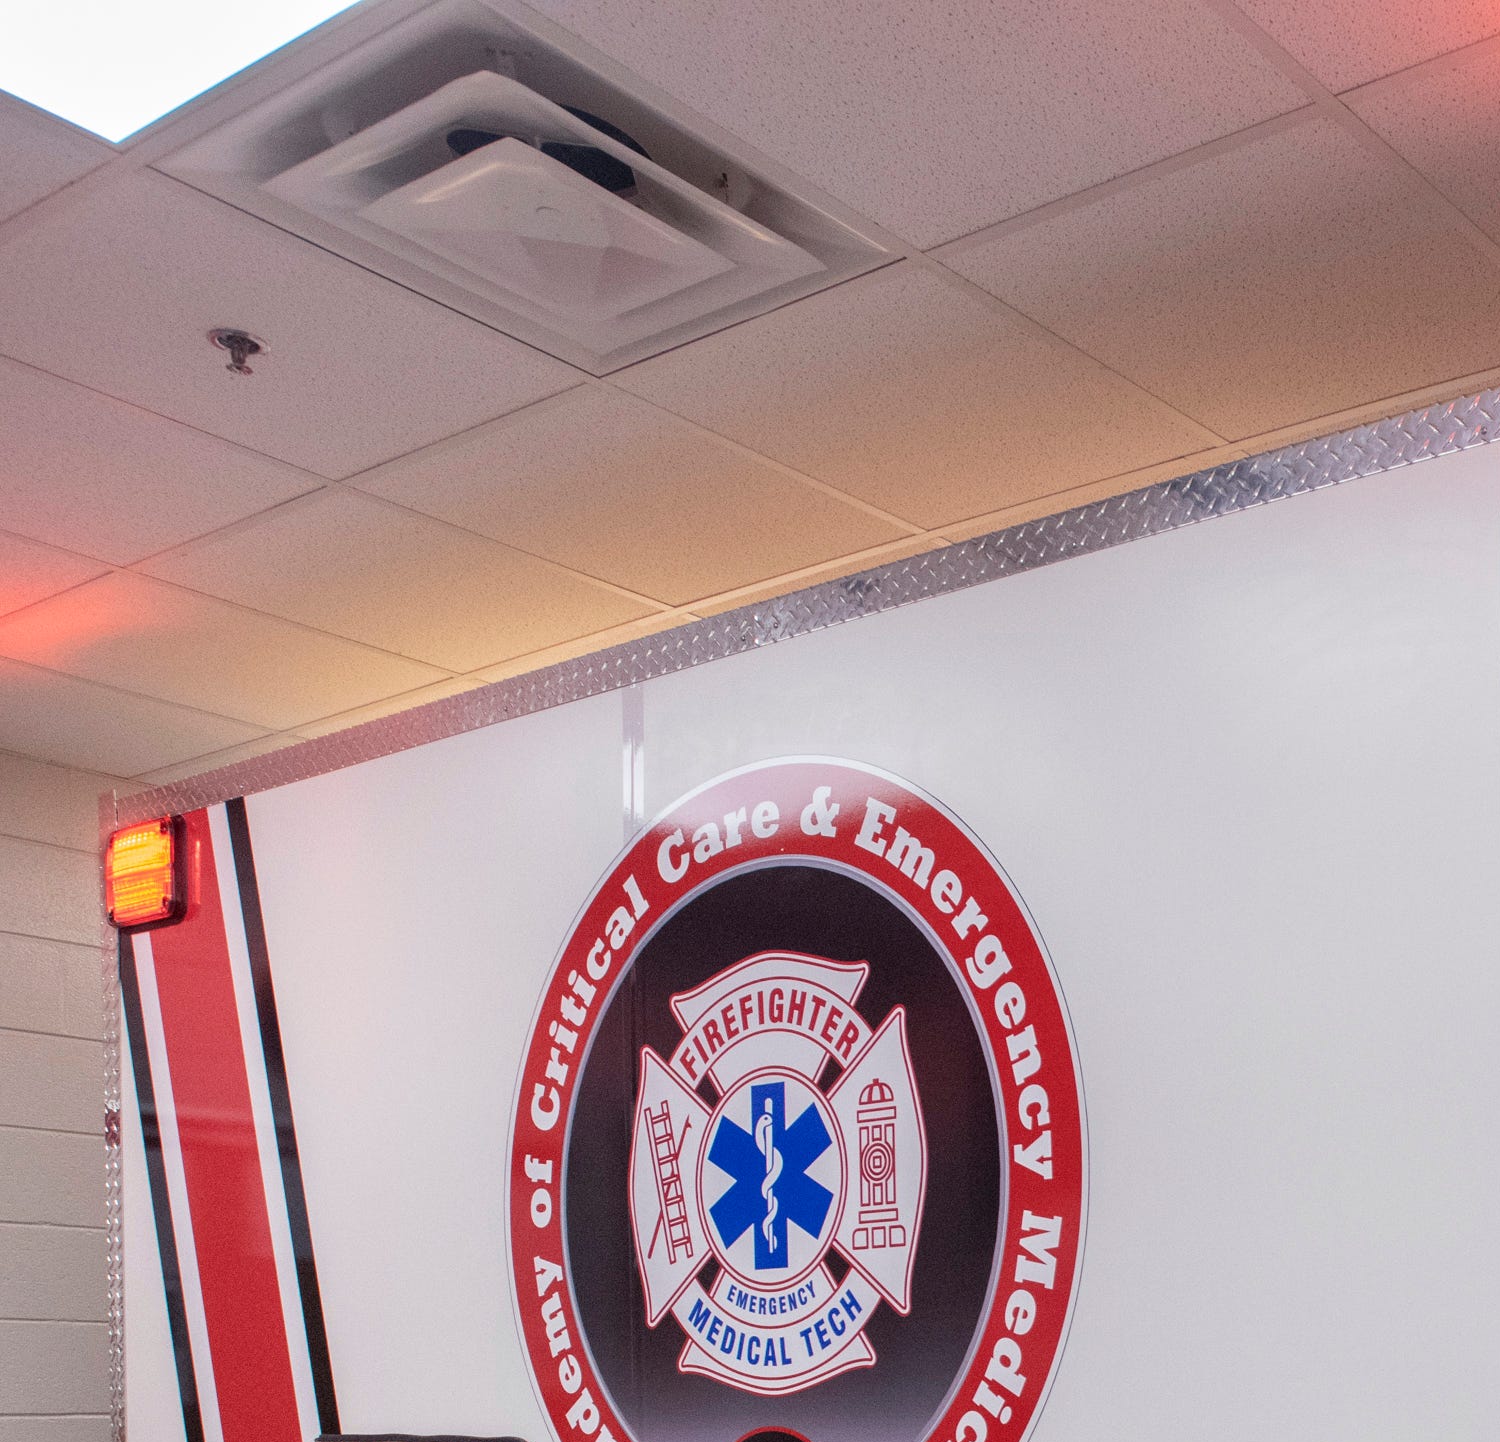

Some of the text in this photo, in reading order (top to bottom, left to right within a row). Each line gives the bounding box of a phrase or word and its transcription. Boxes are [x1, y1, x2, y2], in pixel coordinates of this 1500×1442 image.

[656, 789, 781, 870] Care
[798, 785, 839, 840] &
[530, 884, 650, 1127] Critical
[854, 796, 1055, 1180] Emergency
[679, 989, 861, 1082] FIREFIGHTER
[529, 1157, 553, 1219] of
[687, 1289, 863, 1368] MEDICAL TECH
[726, 1282, 818, 1316] EMERGENCY
